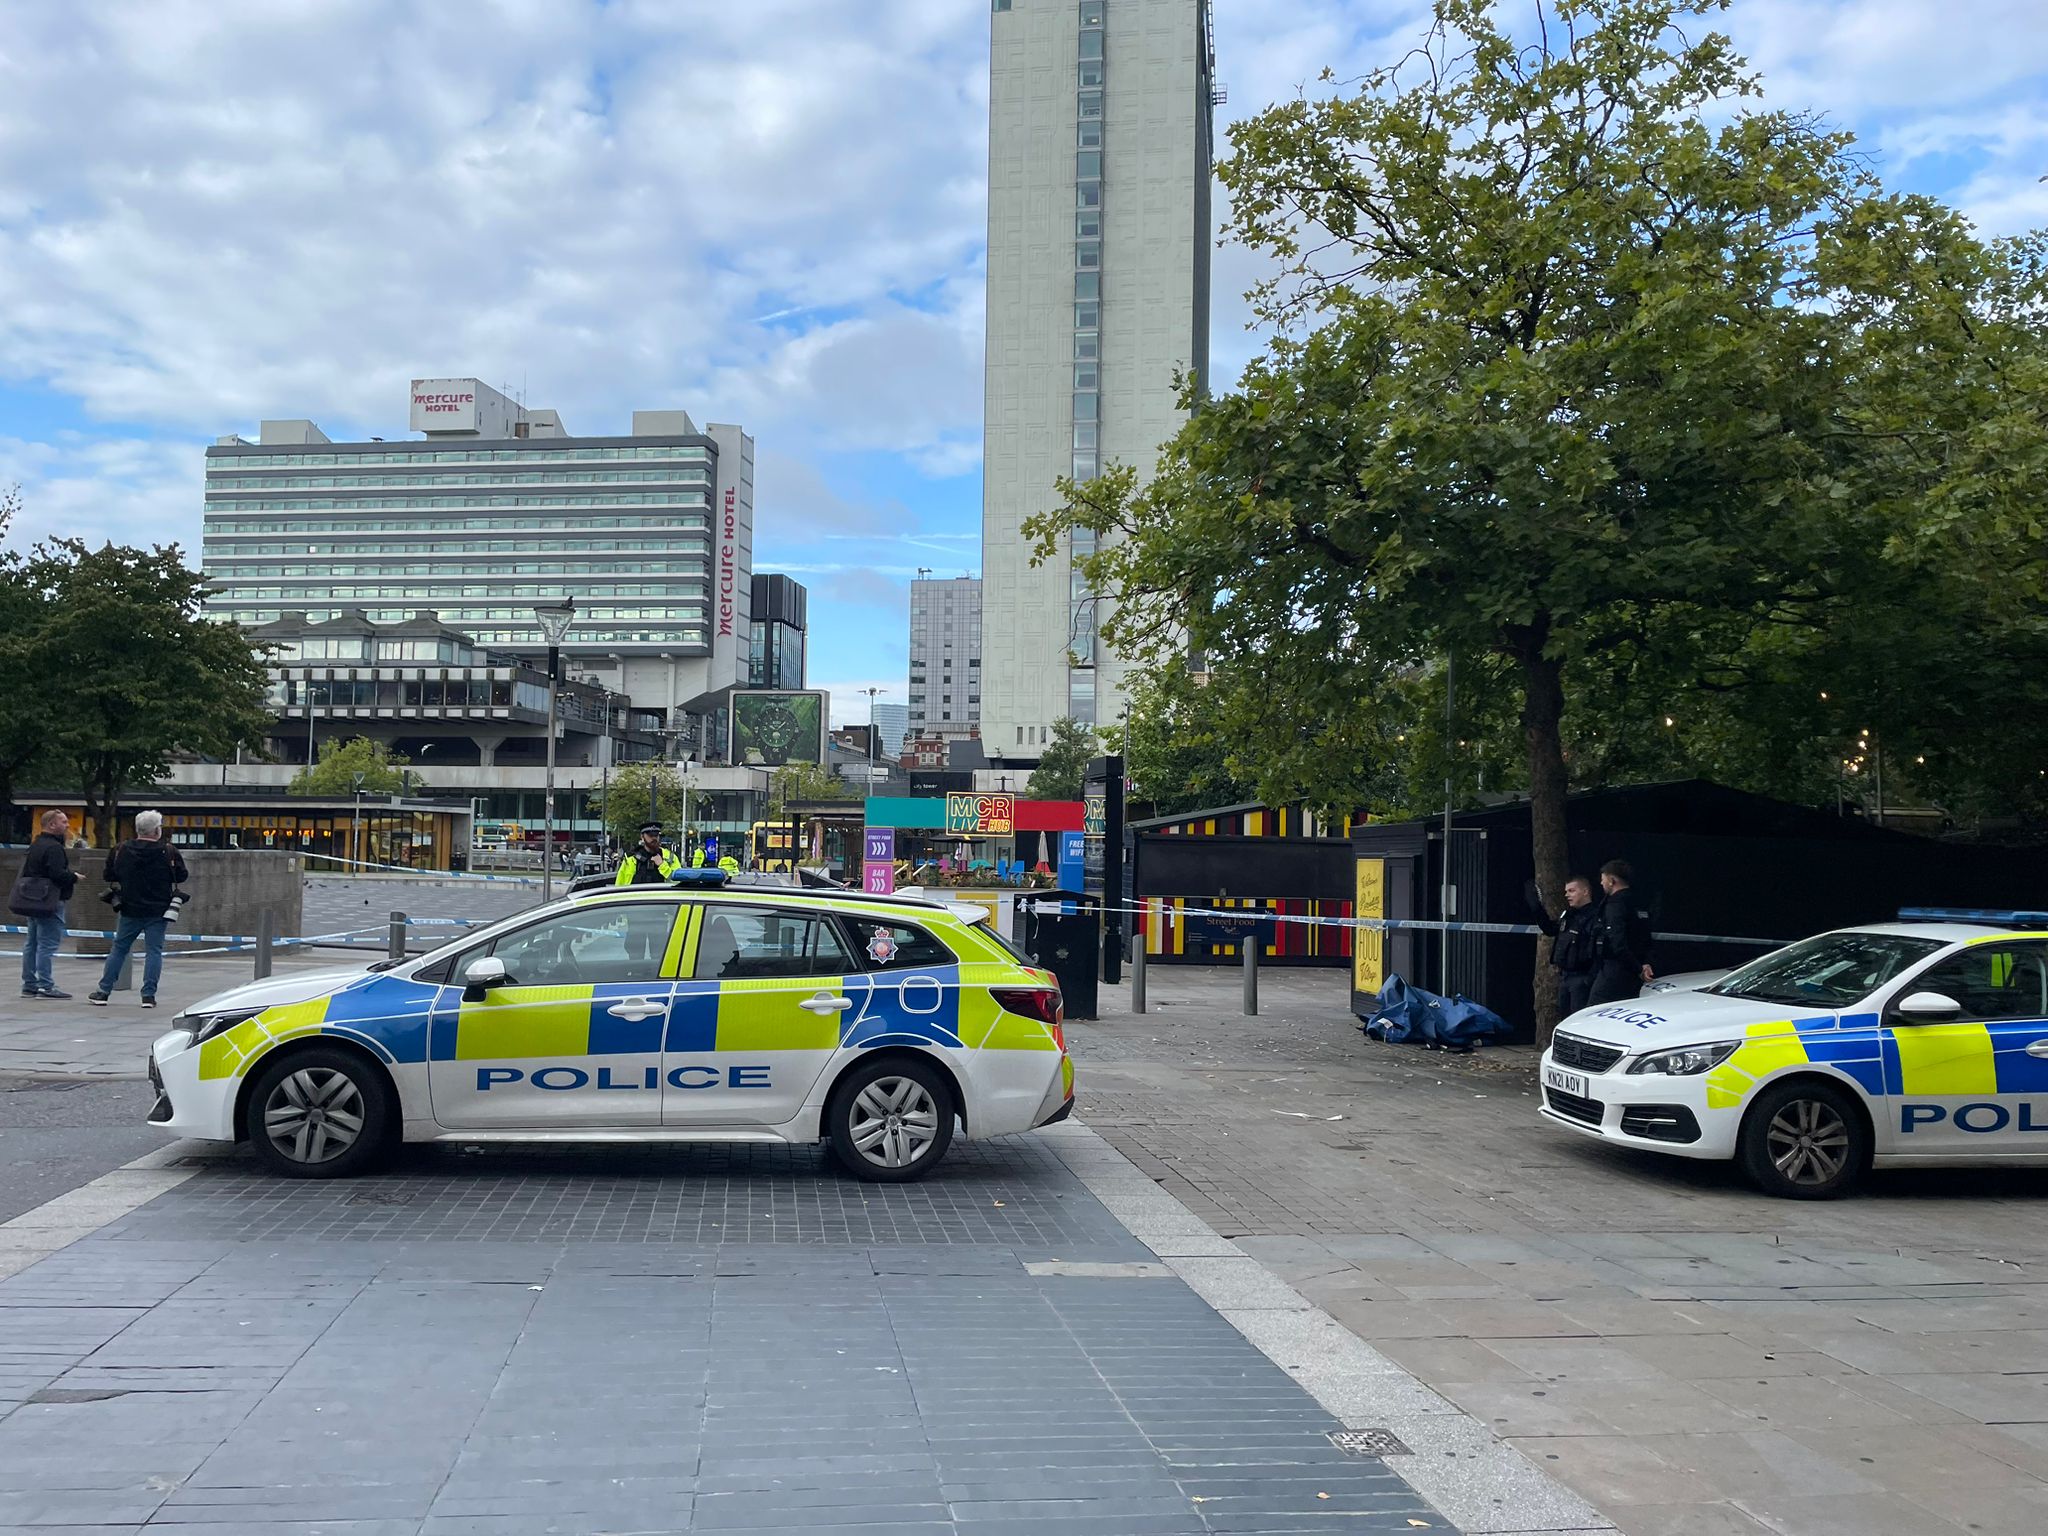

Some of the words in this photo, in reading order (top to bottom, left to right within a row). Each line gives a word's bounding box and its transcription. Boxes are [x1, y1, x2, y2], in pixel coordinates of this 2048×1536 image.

[425, 404, 460, 412] HOTEL
[724, 486, 735, 539] HOTEL
[950, 796, 1010, 818] MCR
[951, 818, 988, 832] LIVE
[987, 819, 1010, 832] HUB
[1069, 840, 1084, 848] FREE
[872, 869, 885, 877] BAR
[1206, 917, 1231, 926] Street
[1233, 918, 1255, 926] Food
[1586, 1007, 1668, 1029] POLICE
[476, 1066, 772, 1091] POLICE
